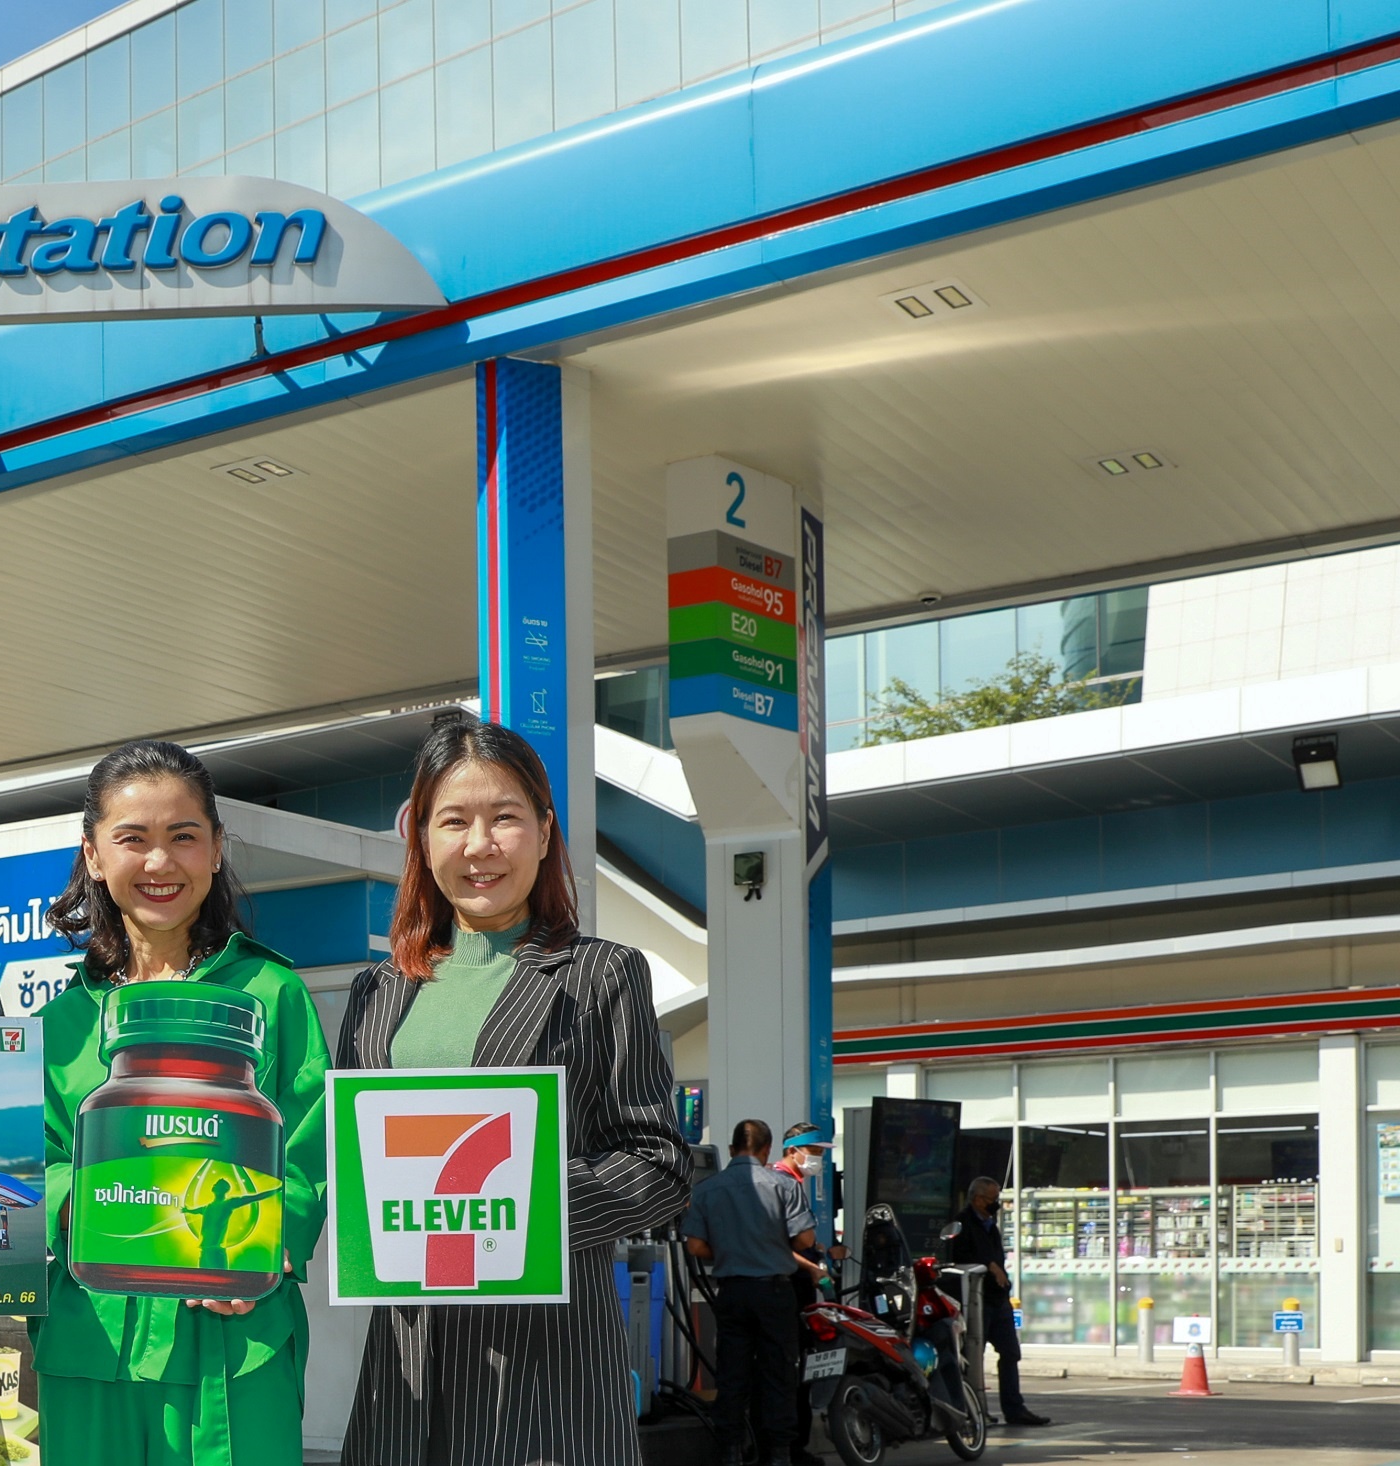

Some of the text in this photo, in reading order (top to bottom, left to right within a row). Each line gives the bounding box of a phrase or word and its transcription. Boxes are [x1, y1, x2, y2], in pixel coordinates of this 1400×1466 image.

[726, 471, 746, 529] 2
[739, 555, 783, 579] Diesel B7
[731, 577, 763, 599] Gasohol
[764, 588, 784, 616] 95
[731, 611, 758, 637] E20
[732, 650, 765, 669] Gasohol
[765, 660, 784, 685] 91
[732, 687, 775, 718] Diesel B7
[145, 1113, 220, 1138] แบรนด์
[19, 1291, 36, 1304] 66
